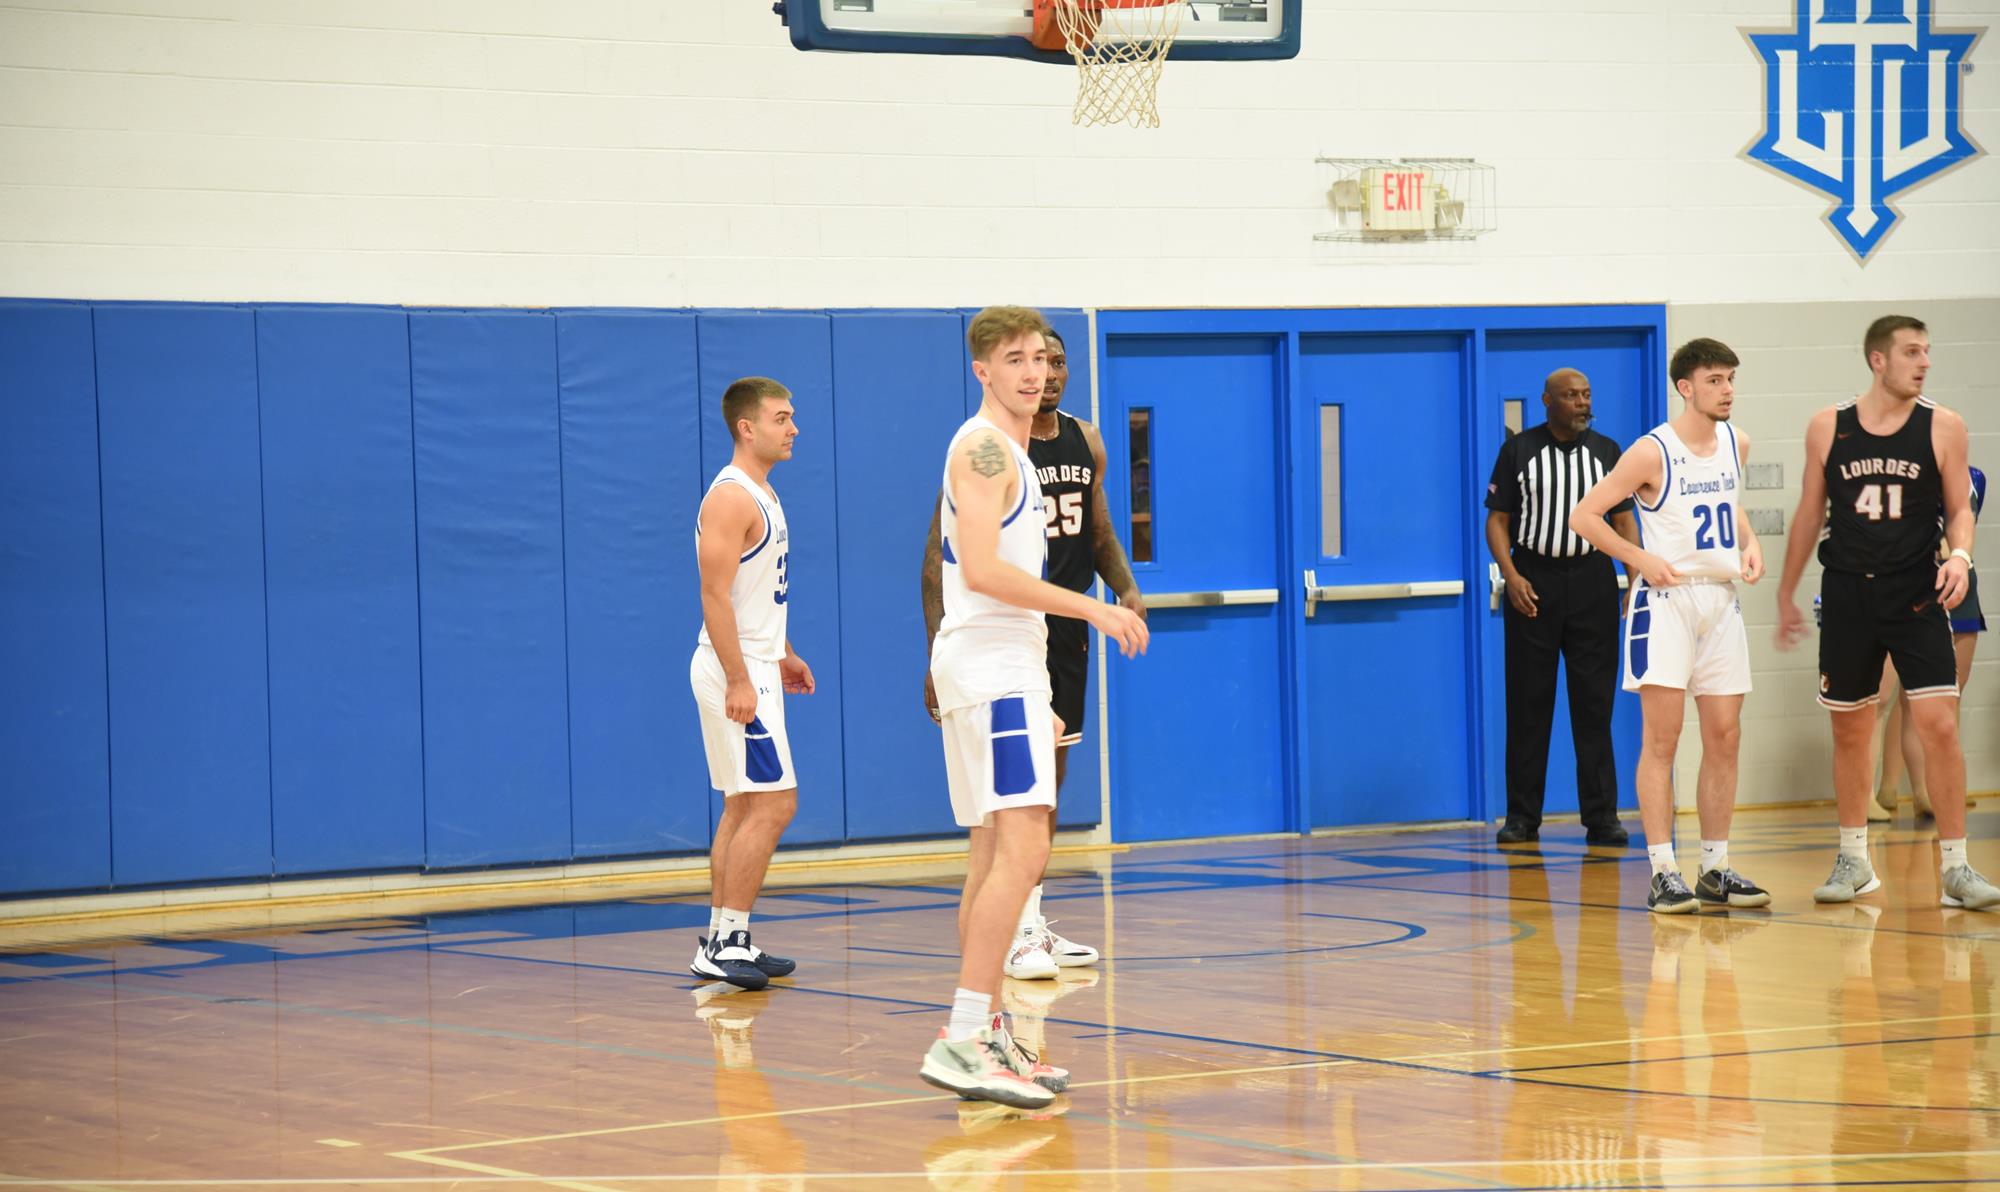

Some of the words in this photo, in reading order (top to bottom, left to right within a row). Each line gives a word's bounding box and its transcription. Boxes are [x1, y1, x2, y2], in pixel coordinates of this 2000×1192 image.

[1383, 173, 1424, 211] EXIT
[1036, 464, 1092, 486] URDES
[1839, 457, 1921, 480] LOURDES
[1042, 491, 1083, 538] 25
[1854, 484, 1903, 520] 41
[1692, 502, 1735, 550] 20
